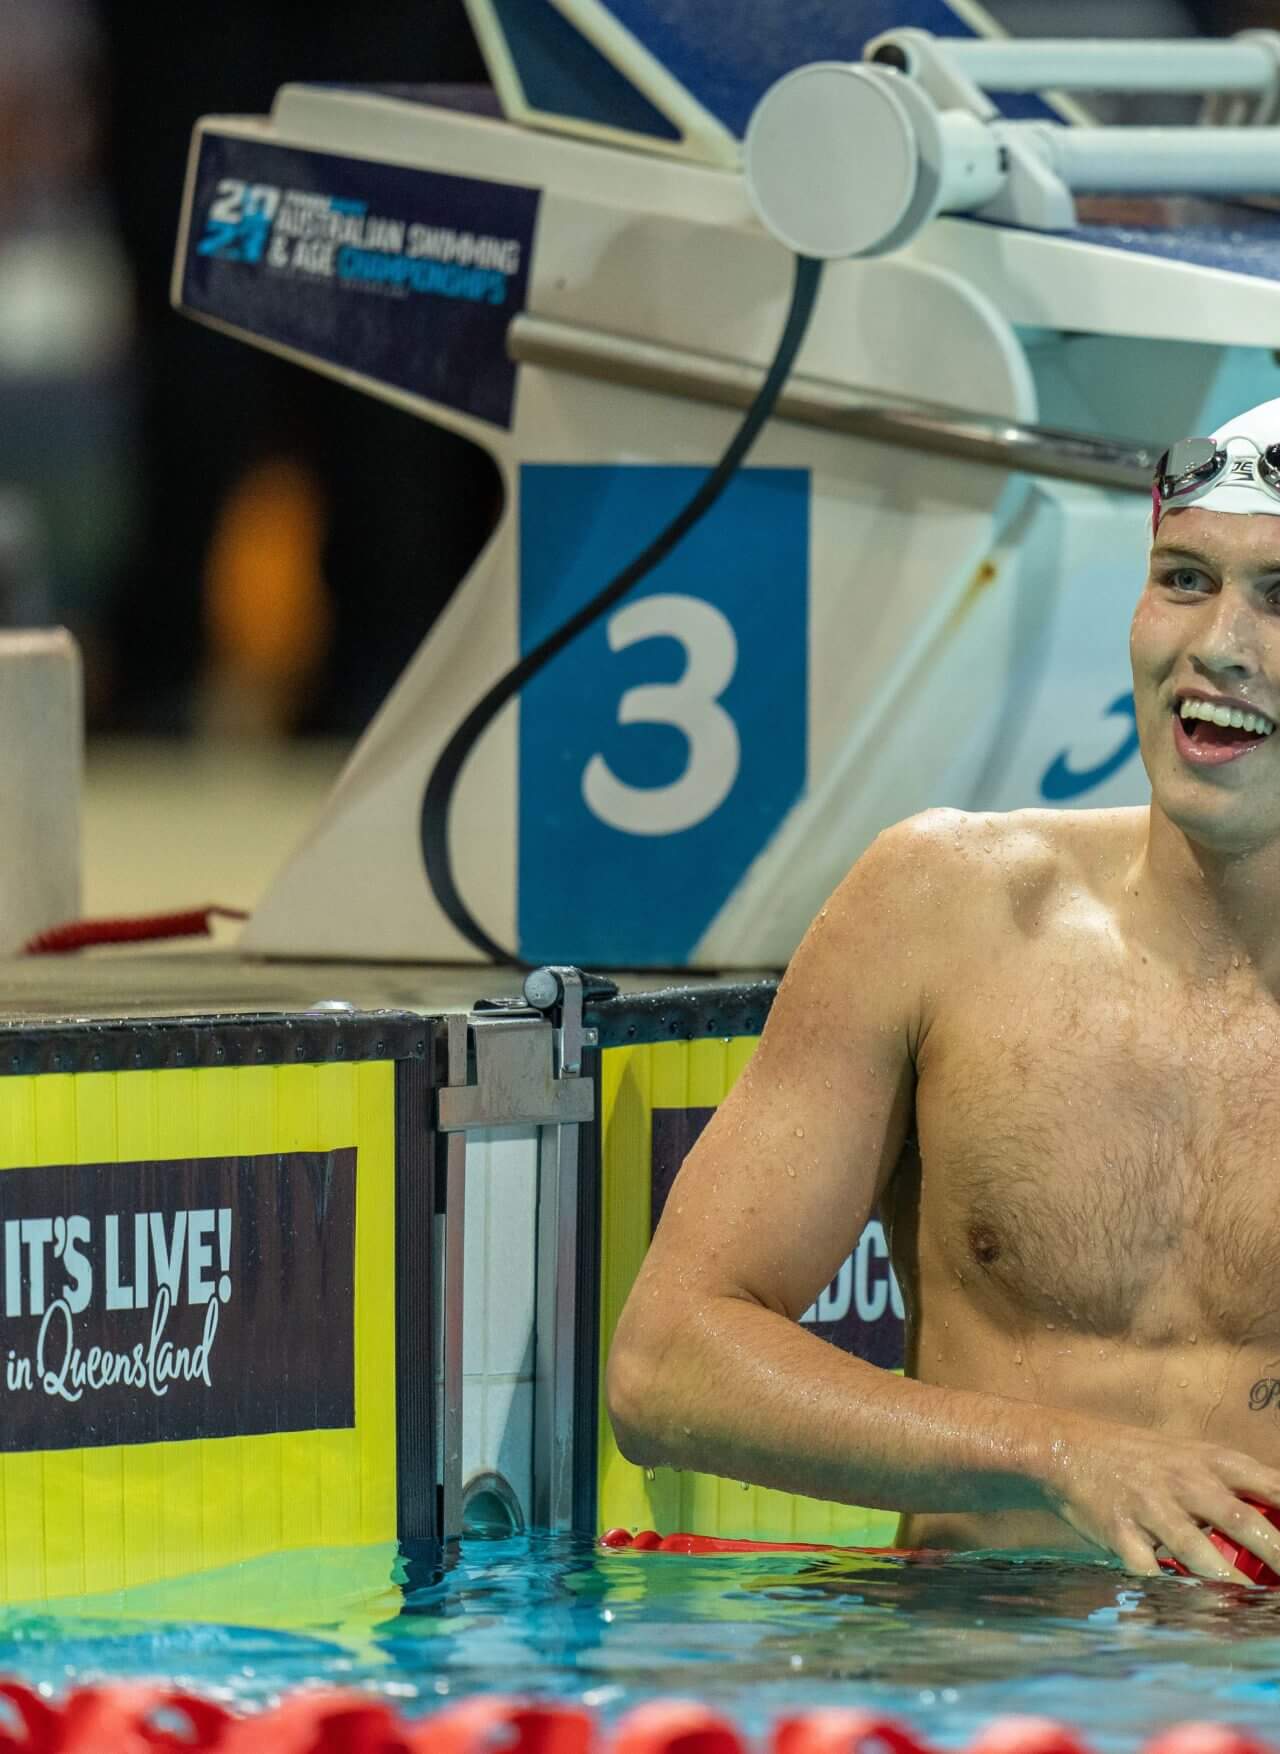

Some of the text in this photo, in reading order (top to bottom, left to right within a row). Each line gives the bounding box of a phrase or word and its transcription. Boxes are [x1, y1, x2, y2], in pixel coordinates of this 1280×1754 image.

[275, 207, 521, 275] AUSTRALIAN SWIMMING
[292, 239, 335, 277] AGE
[581, 593, 741, 835] 3
[5, 1208, 232, 1318] IT'S LIVE!
[7, 1287, 218, 1401] in Queensland
